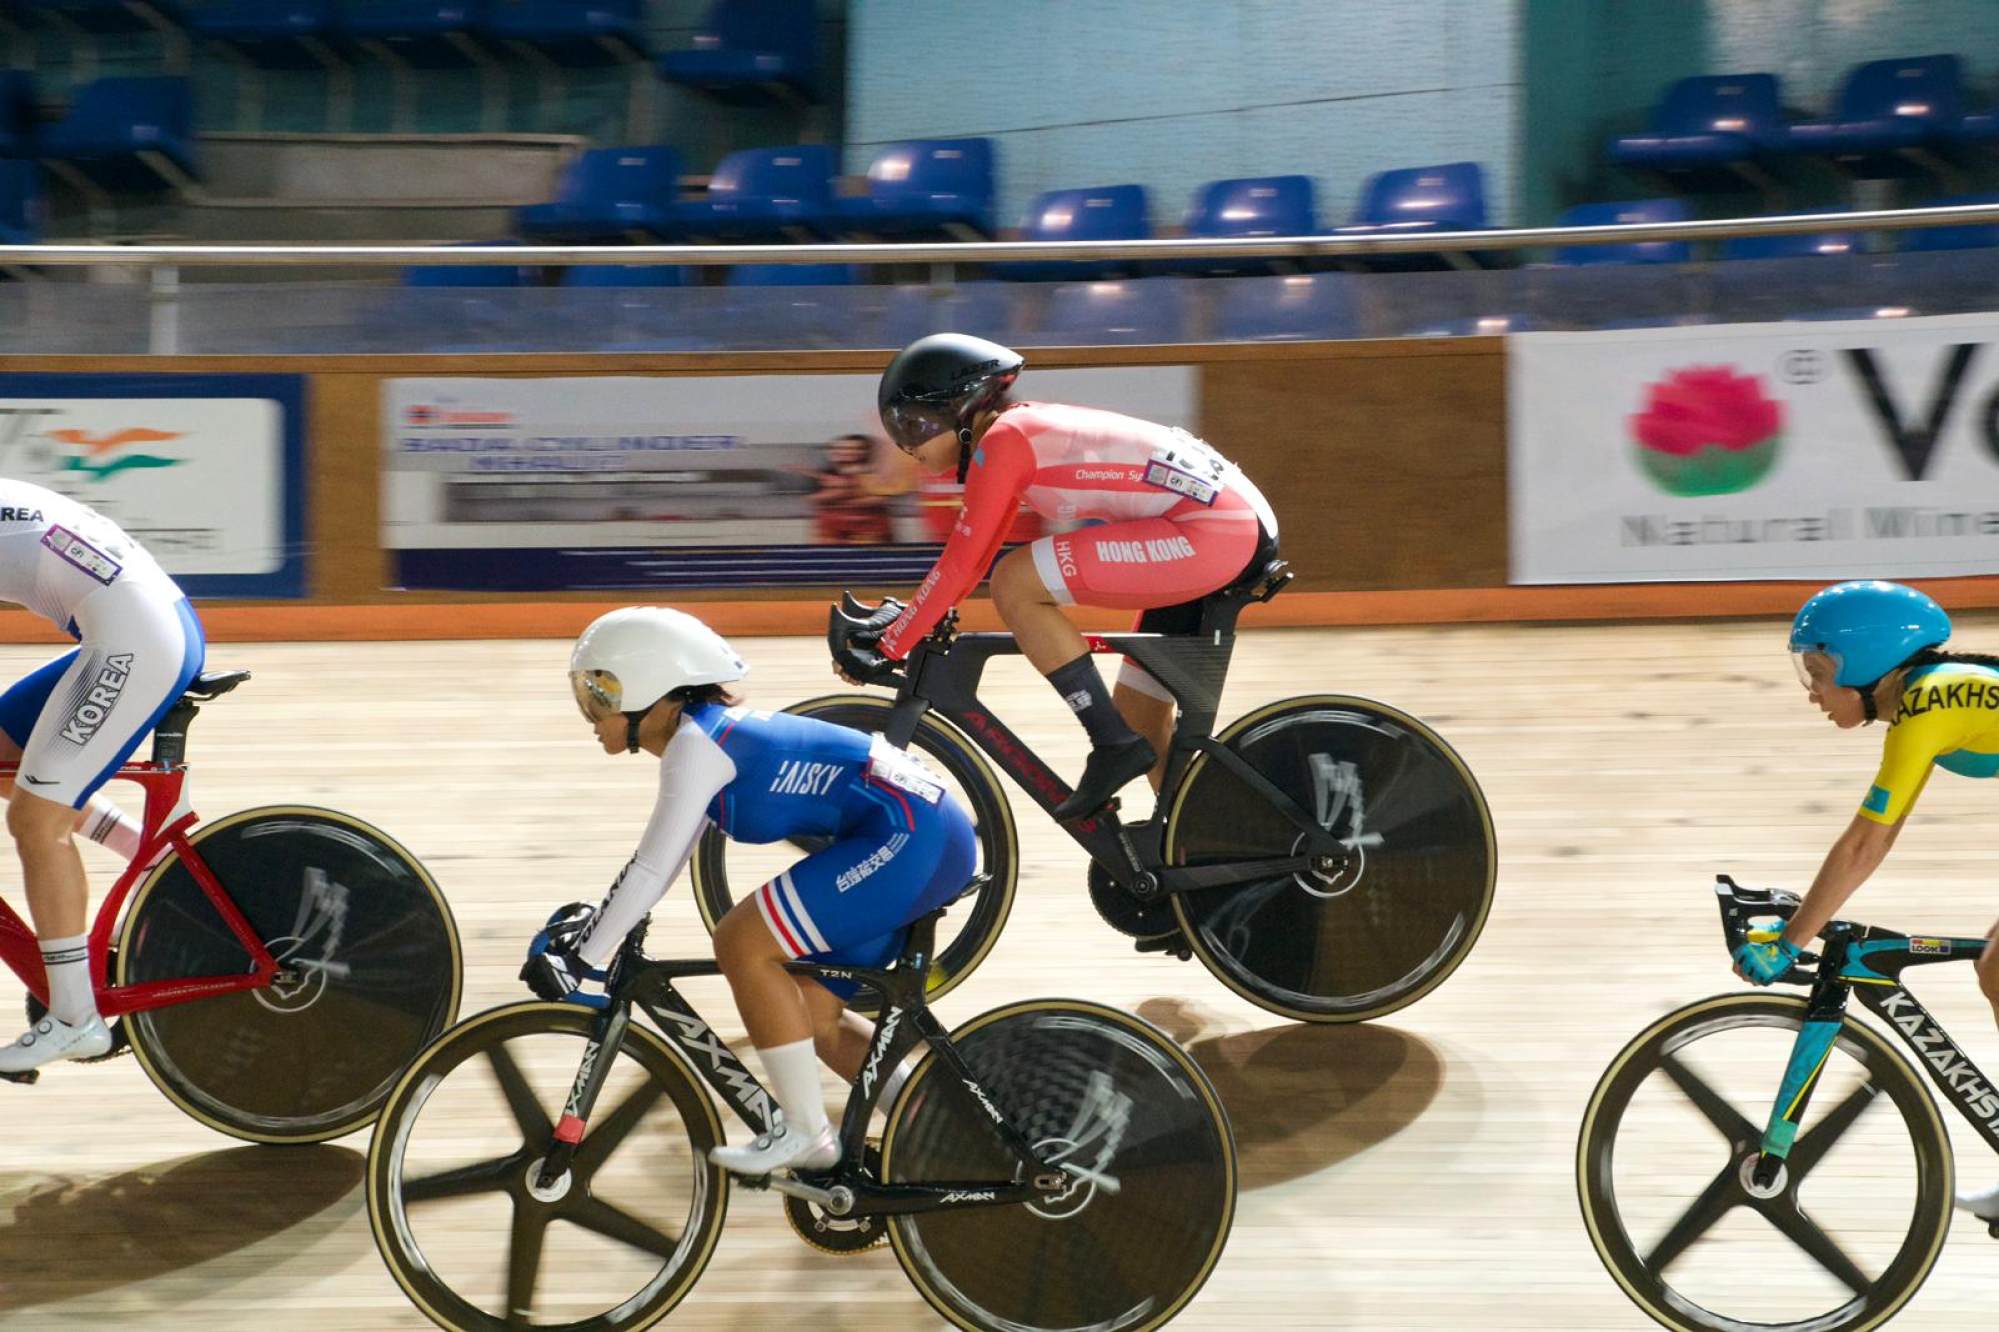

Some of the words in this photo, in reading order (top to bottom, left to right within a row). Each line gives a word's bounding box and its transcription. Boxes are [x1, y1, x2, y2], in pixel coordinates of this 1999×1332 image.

[1075, 468, 1125, 481] Champion
[1056, 541, 1078, 577] HKG
[1095, 540, 1147, 563] HONG
[1145, 535, 1197, 562] KONG
[60, 653, 134, 746] KOREA
[652, 1005, 784, 1136] AXMA
[863, 1005, 903, 1100] AXMAN
